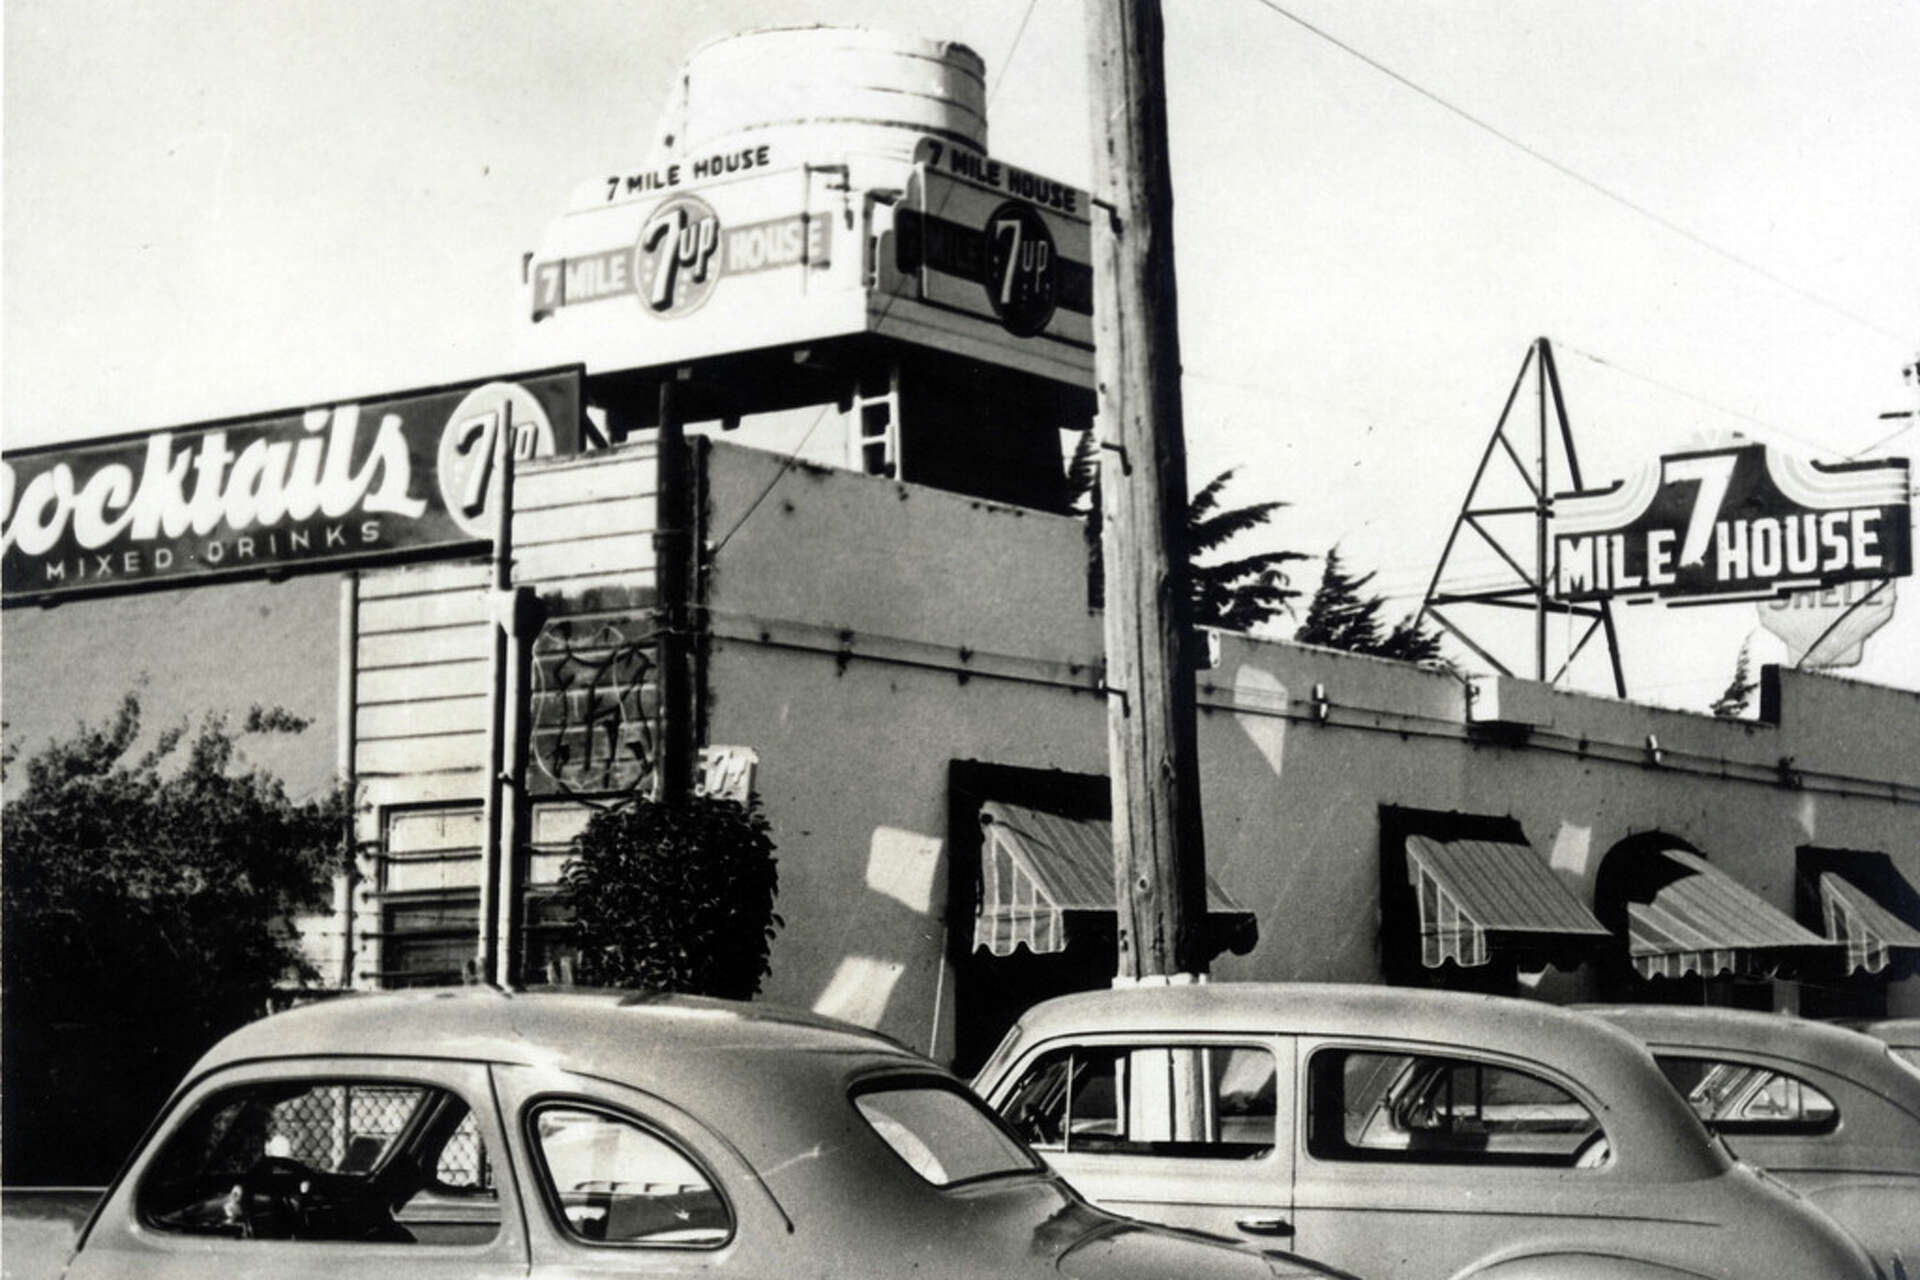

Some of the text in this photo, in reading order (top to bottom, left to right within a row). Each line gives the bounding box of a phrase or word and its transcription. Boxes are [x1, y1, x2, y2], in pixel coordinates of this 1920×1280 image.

[607, 145, 770, 201] 7 MILE HOUSE
[930, 141, 1077, 213] 7 MILE HOUSE
[541, 217, 823, 305] 7 MILE HOUSE
[1664, 454, 1739, 568] 7
[46, 522, 380, 582] MIXED DRINKS
[1558, 508, 1883, 595] MILE HOUSE
